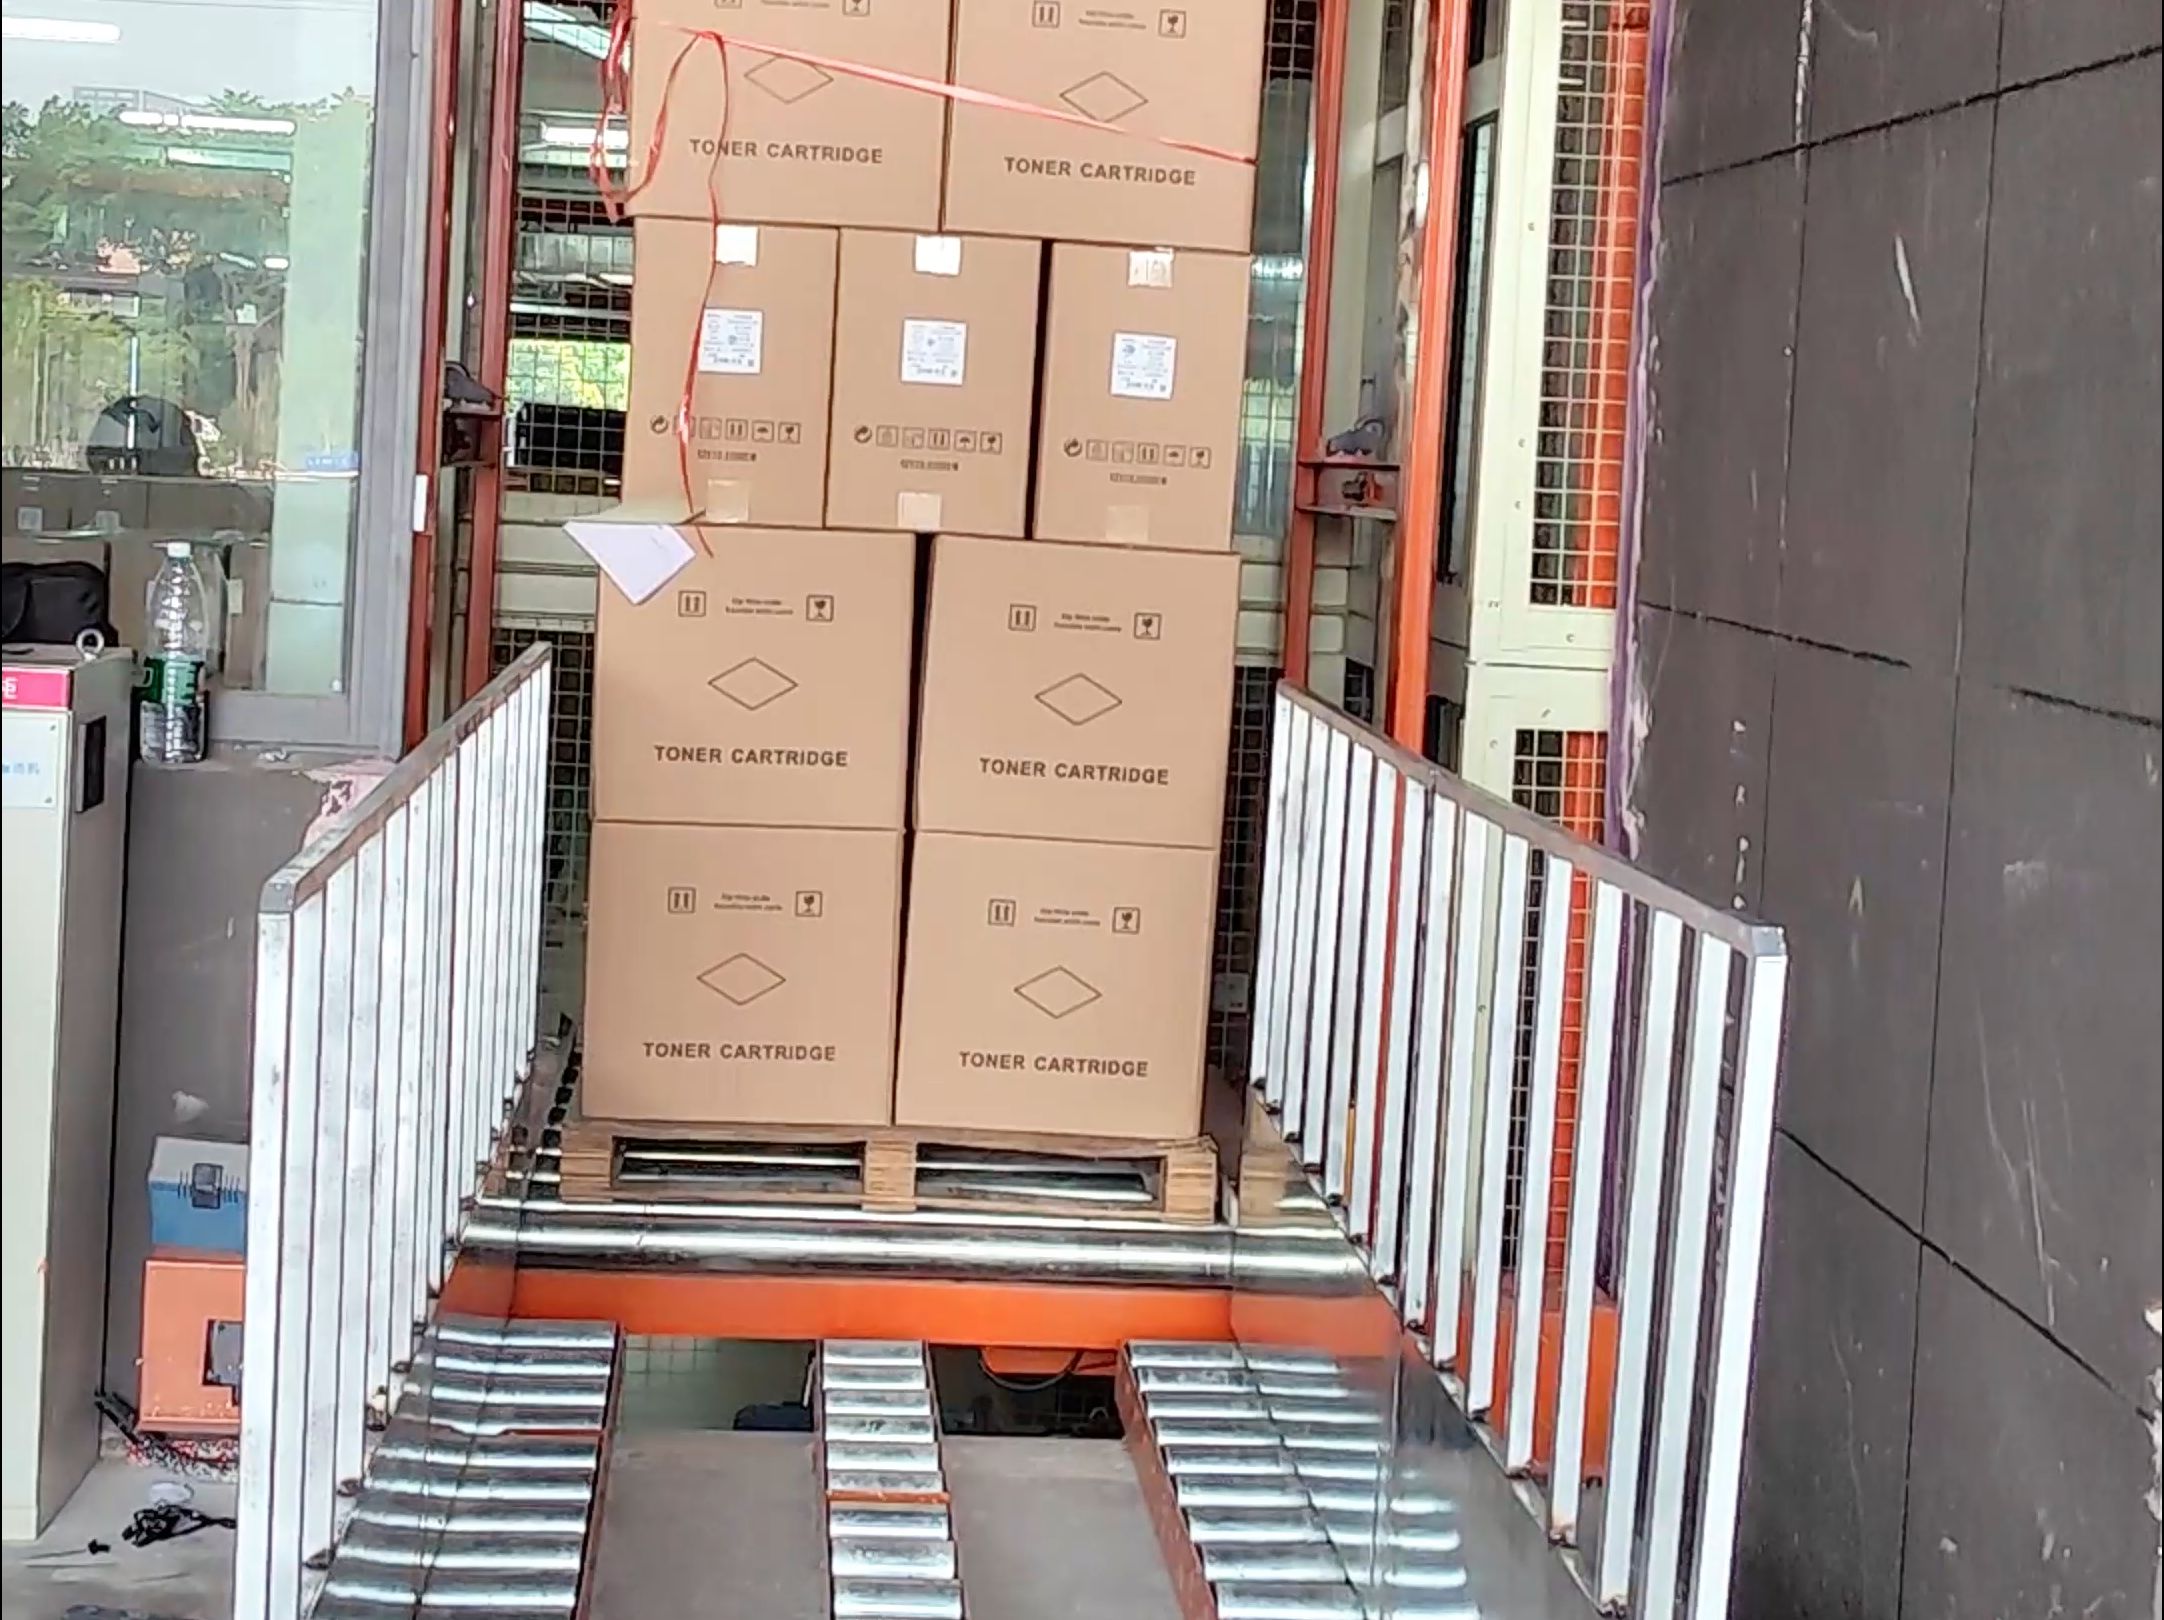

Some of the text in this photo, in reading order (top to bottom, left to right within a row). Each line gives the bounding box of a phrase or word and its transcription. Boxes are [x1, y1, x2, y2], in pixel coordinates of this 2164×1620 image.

[689, 138, 883, 164] TONER CARTRIDGE
[1004, 156, 1196, 186] TONER CARTRIDGE
[653, 744, 848, 768] TONER CARTRIDGE
[979, 757, 1169, 786] TONER CARTRIDGE
[642, 1042, 836, 1063] TONER CARTRIDGE
[959, 1051, 1149, 1078] TONER CARTRIDGE
